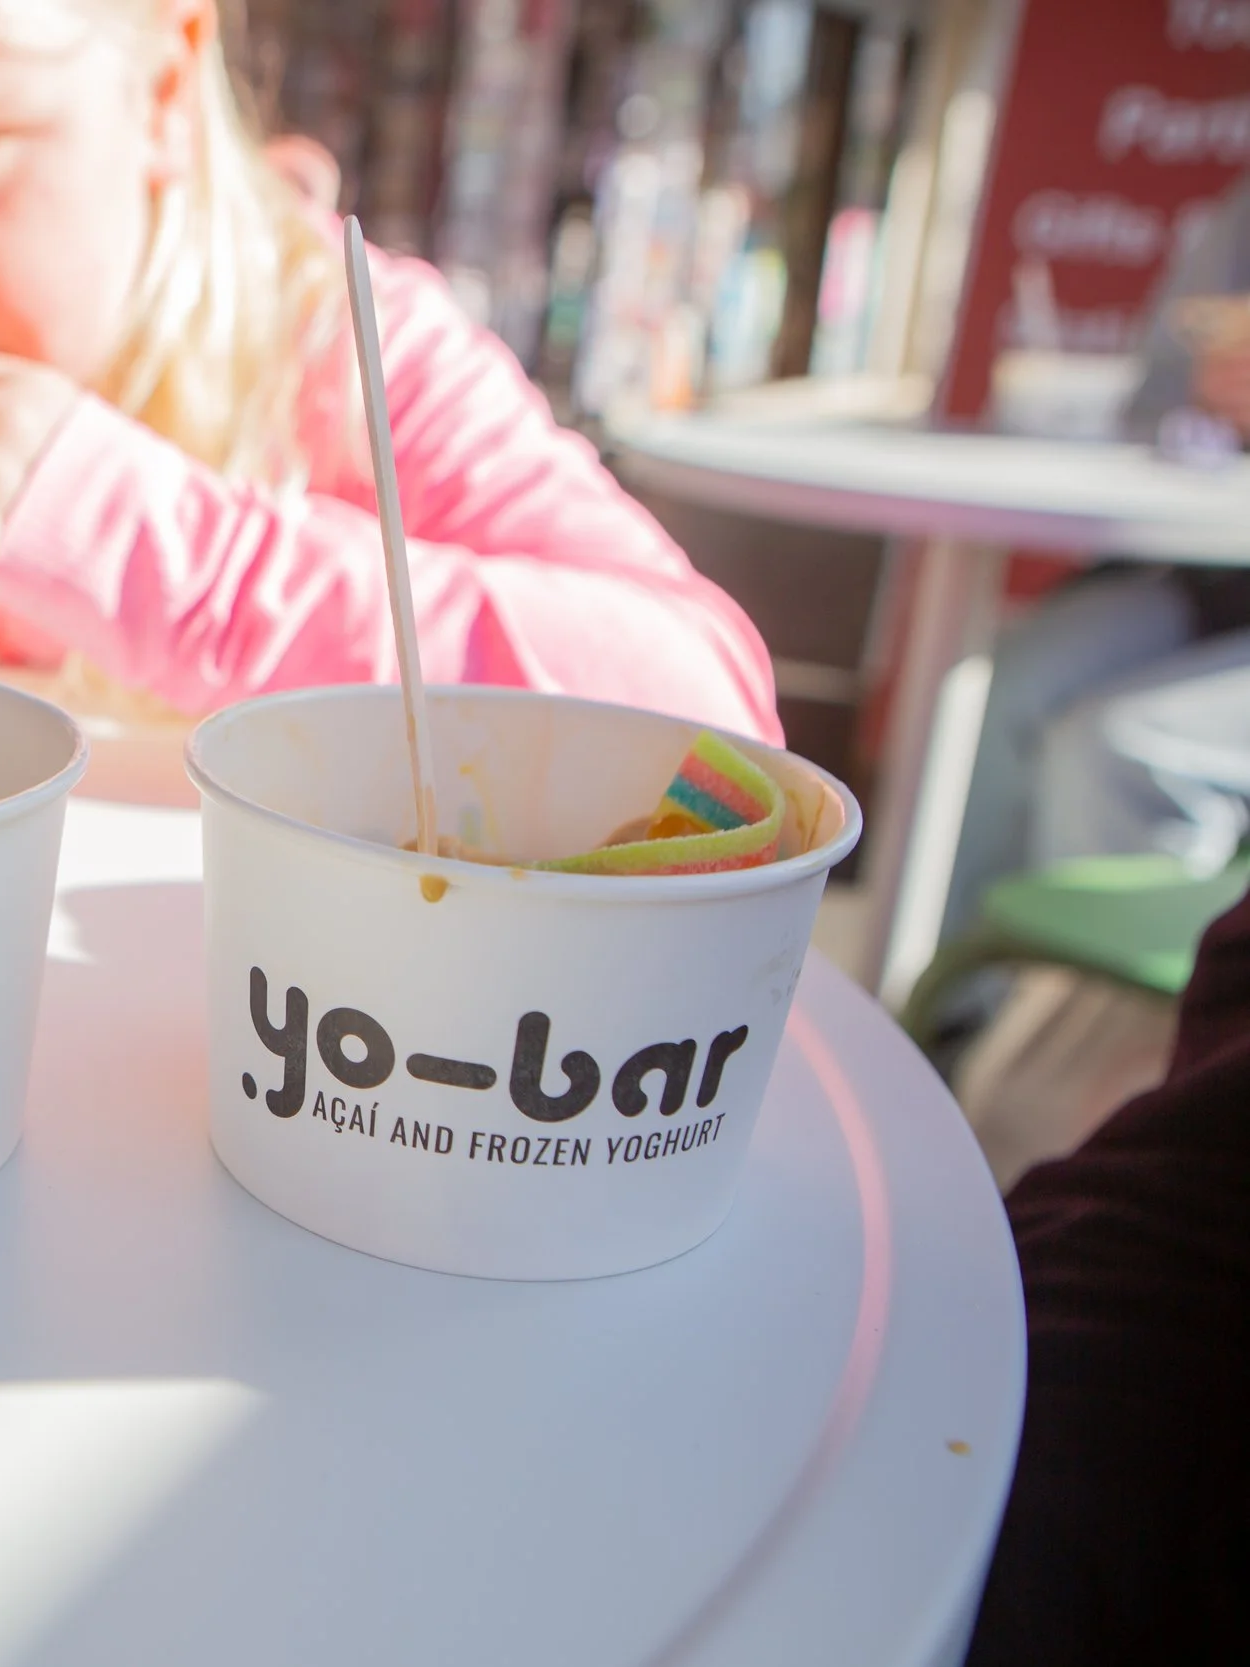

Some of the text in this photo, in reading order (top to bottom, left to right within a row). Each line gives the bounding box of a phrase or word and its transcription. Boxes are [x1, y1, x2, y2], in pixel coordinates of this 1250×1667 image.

[241, 965, 749, 1123] yo-bar
[312, 1090, 727, 1166] AÇAÍ AND FROZEN YOGHURT
